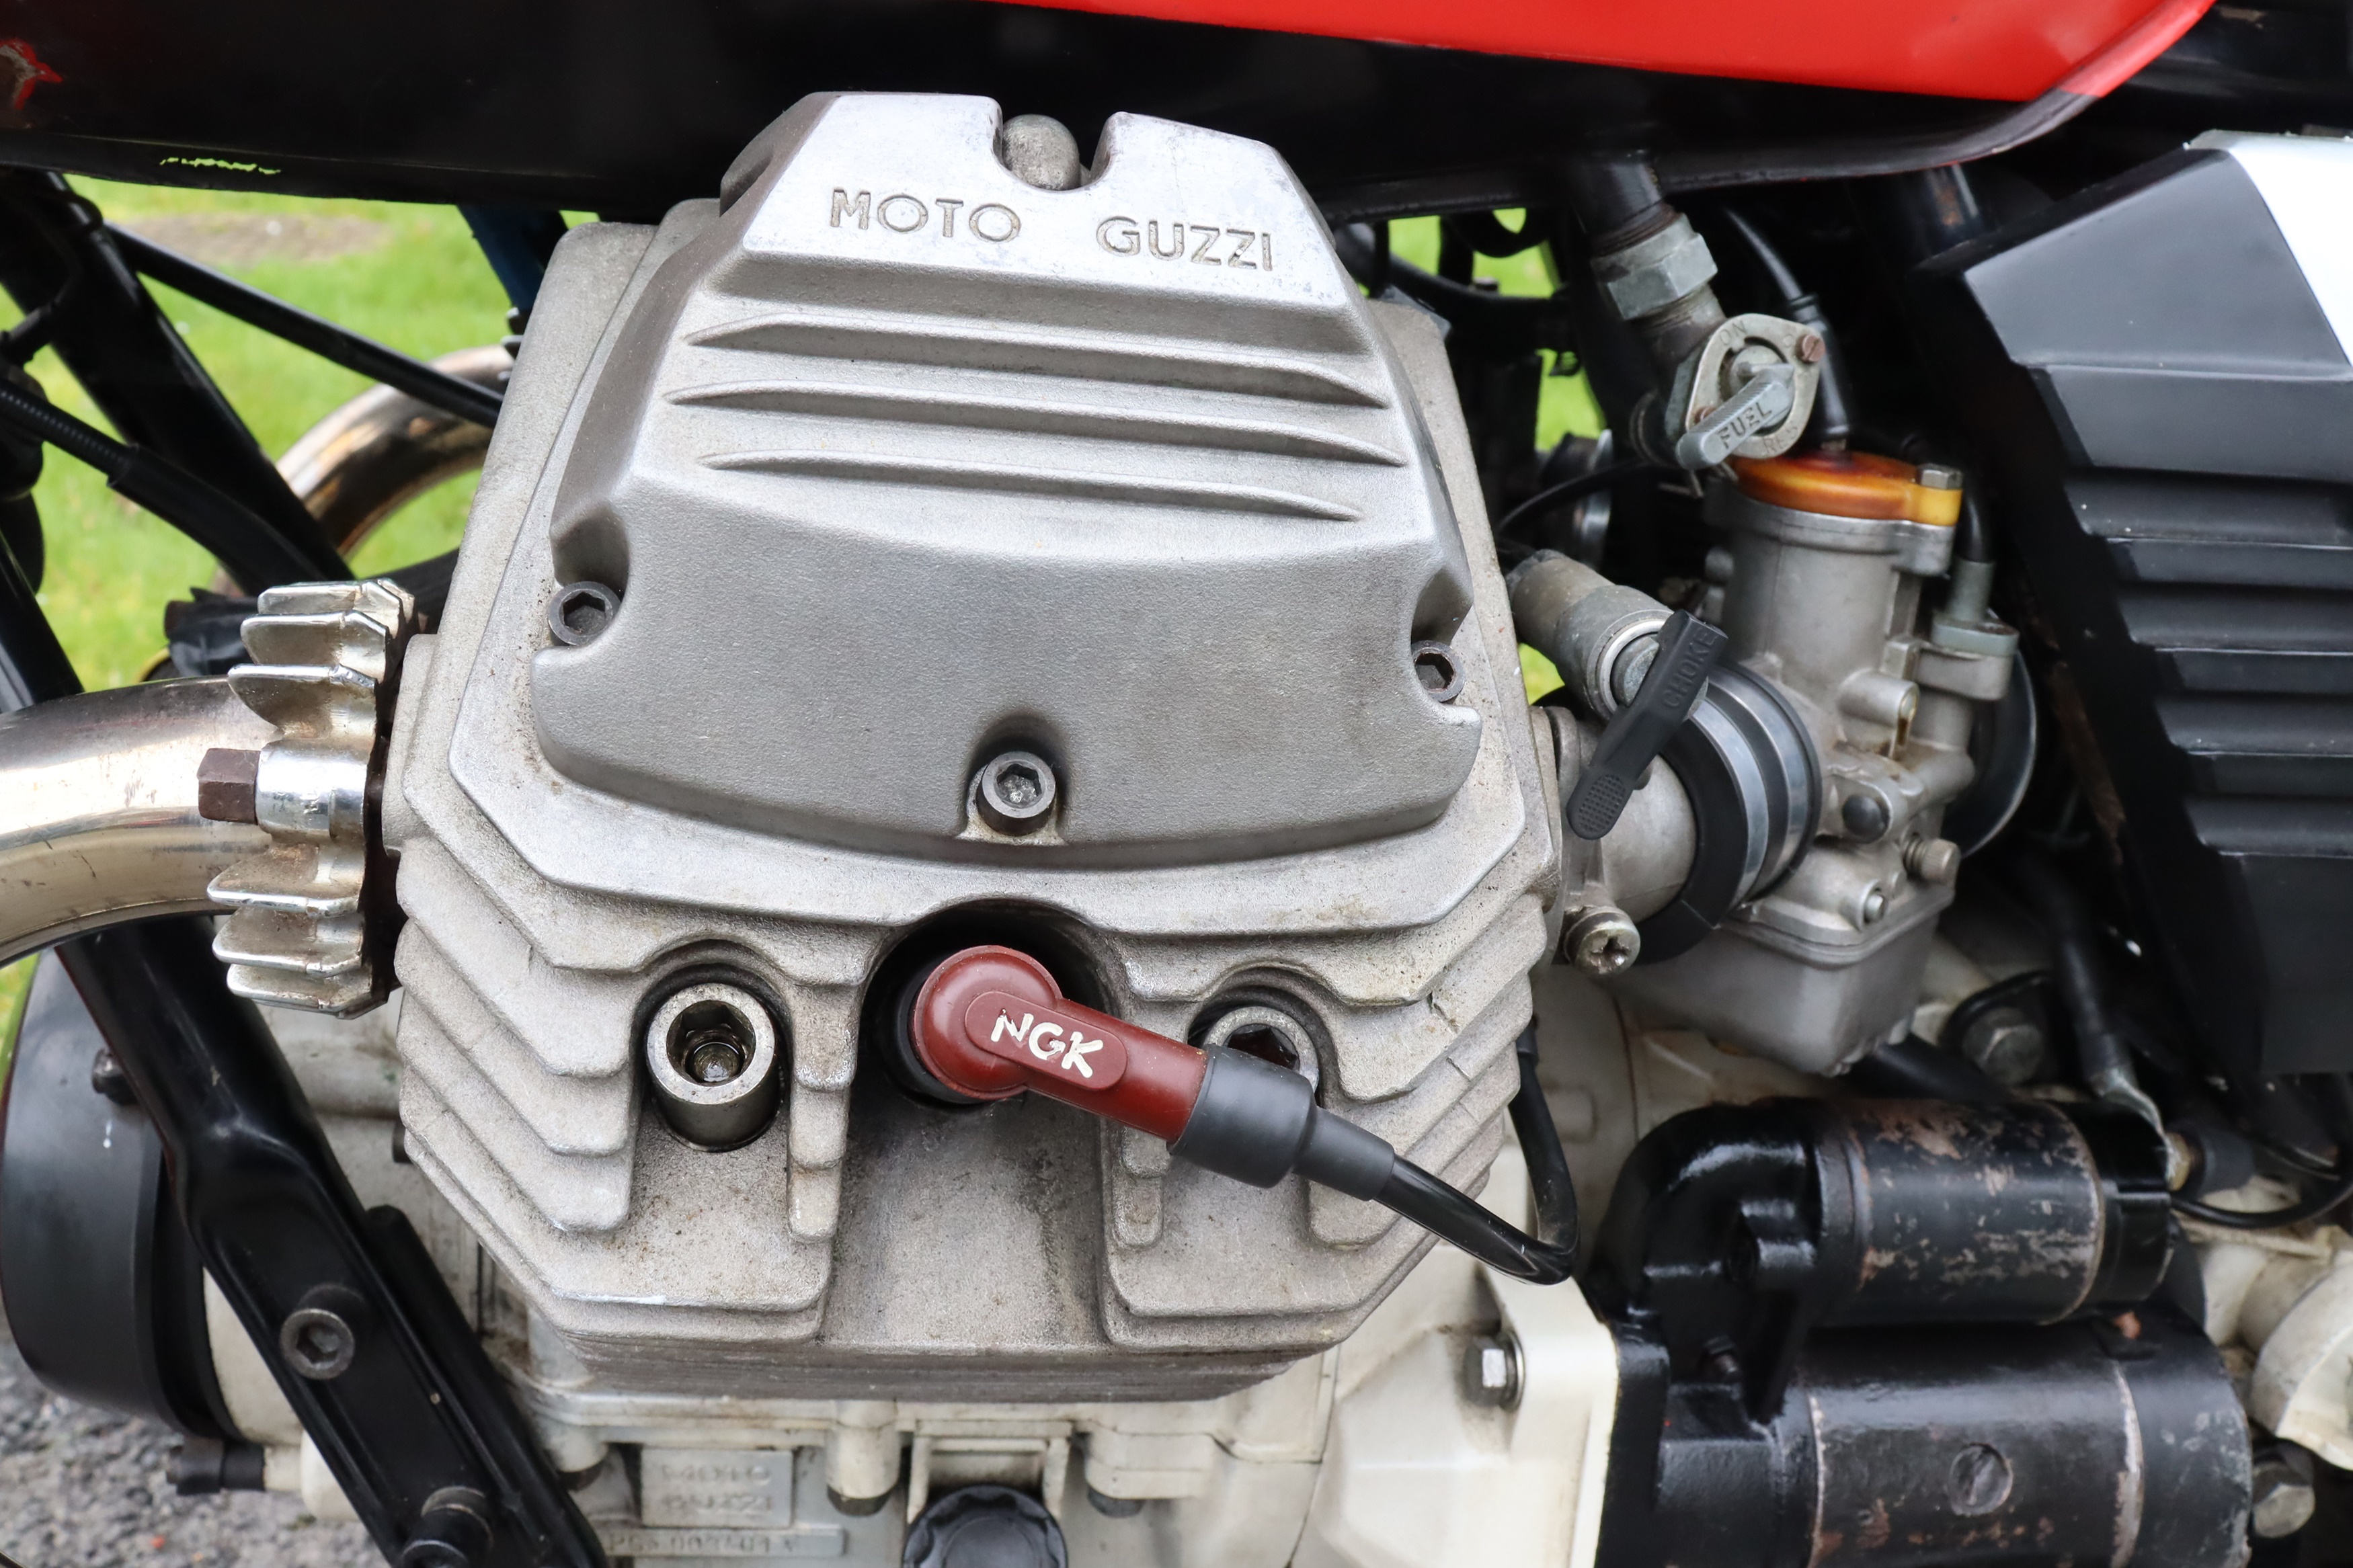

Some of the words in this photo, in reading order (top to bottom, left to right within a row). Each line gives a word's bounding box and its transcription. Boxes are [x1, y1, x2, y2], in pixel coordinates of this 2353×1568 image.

[830, 189, 1022, 243] MOTO
[1095, 216, 1273, 271] GUZZI
[1719, 319, 1747, 346] ON
[1718, 401, 1773, 450] FUEL
[1763, 425, 1800, 455] RES
[1663, 626, 1719, 707] CHOKE
[990, 1008, 1104, 1078] NGK
